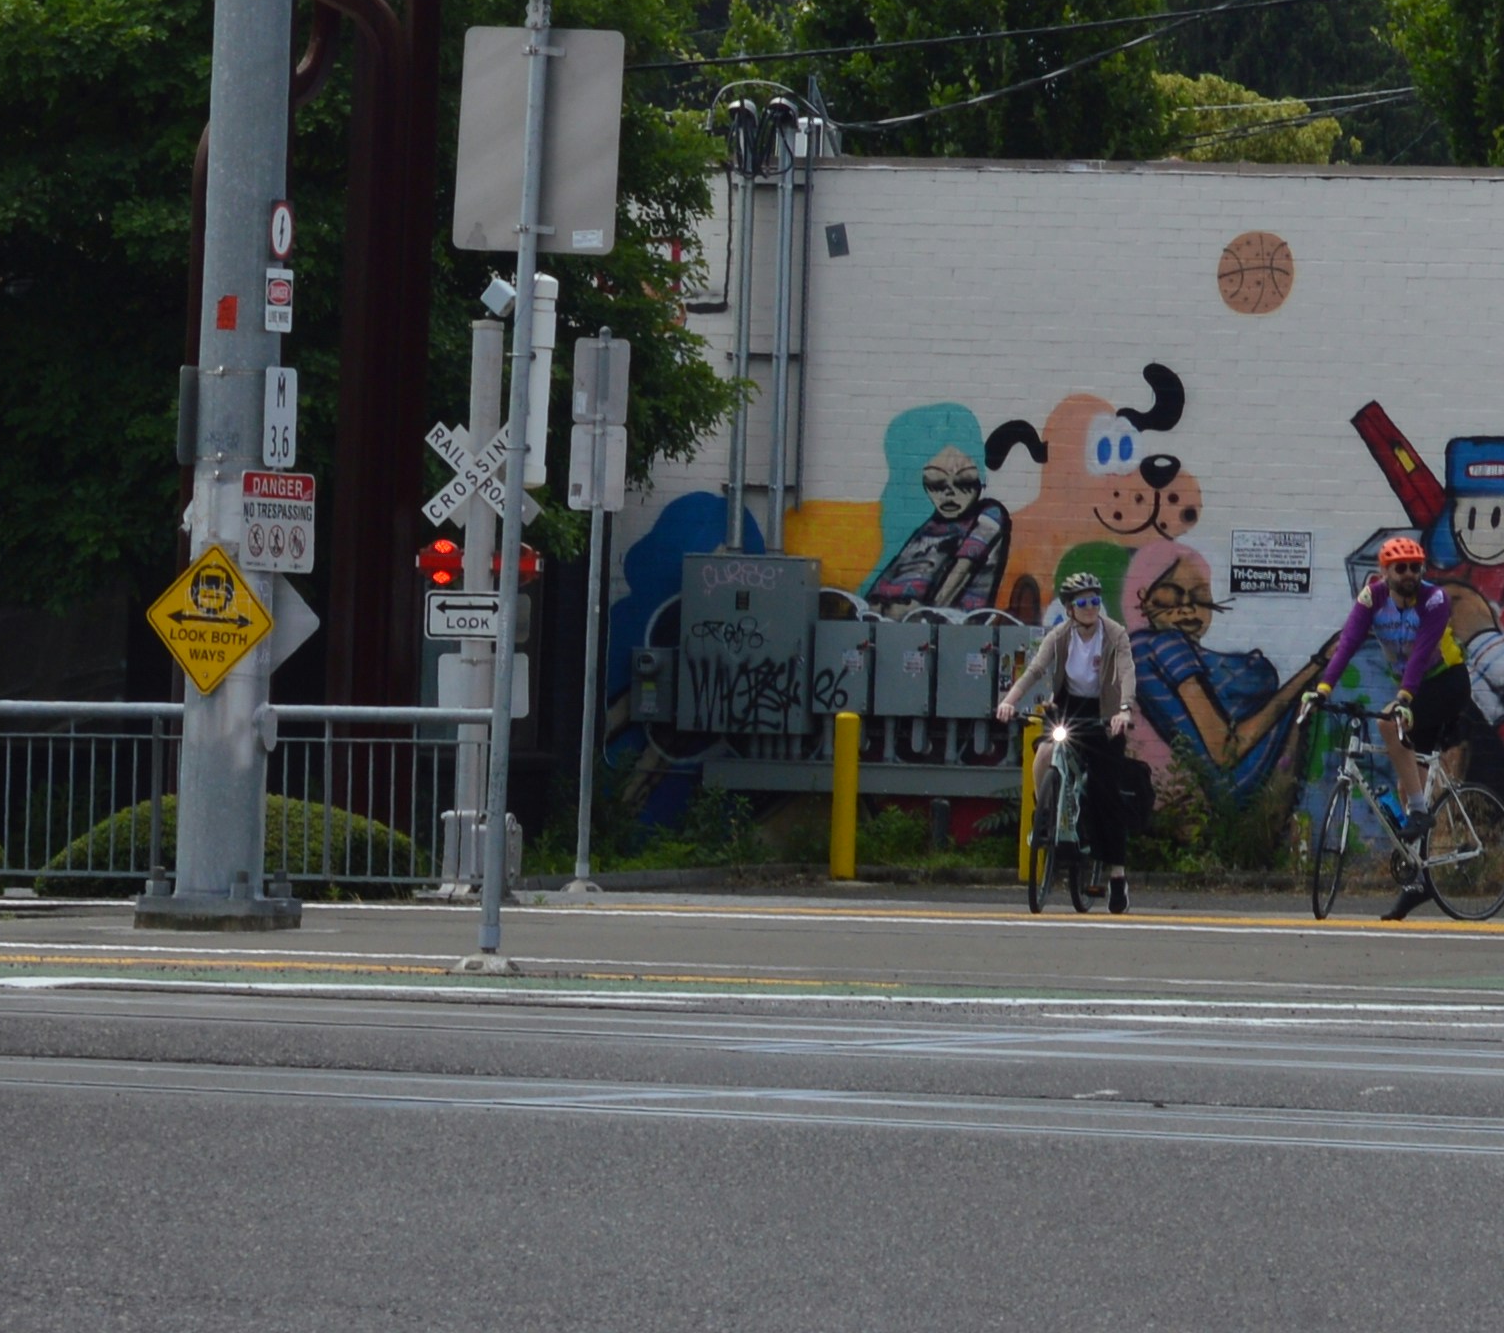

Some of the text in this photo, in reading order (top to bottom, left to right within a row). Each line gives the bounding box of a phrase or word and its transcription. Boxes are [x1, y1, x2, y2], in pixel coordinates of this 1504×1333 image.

[276, 375, 287, 409] M
[428, 429, 510, 520] CROSSIN
[430, 427, 506, 512] RAIL ROA
[252, 476, 304, 498] DANGER
[243, 501, 313, 522] NO TRESPASSING
[1232, 567, 1308, 585] Tri-County Towing
[446, 616, 490, 630] LOOK
[169, 627, 248, 646] LOOK BOTH
[189, 648, 226, 663] WAYS
